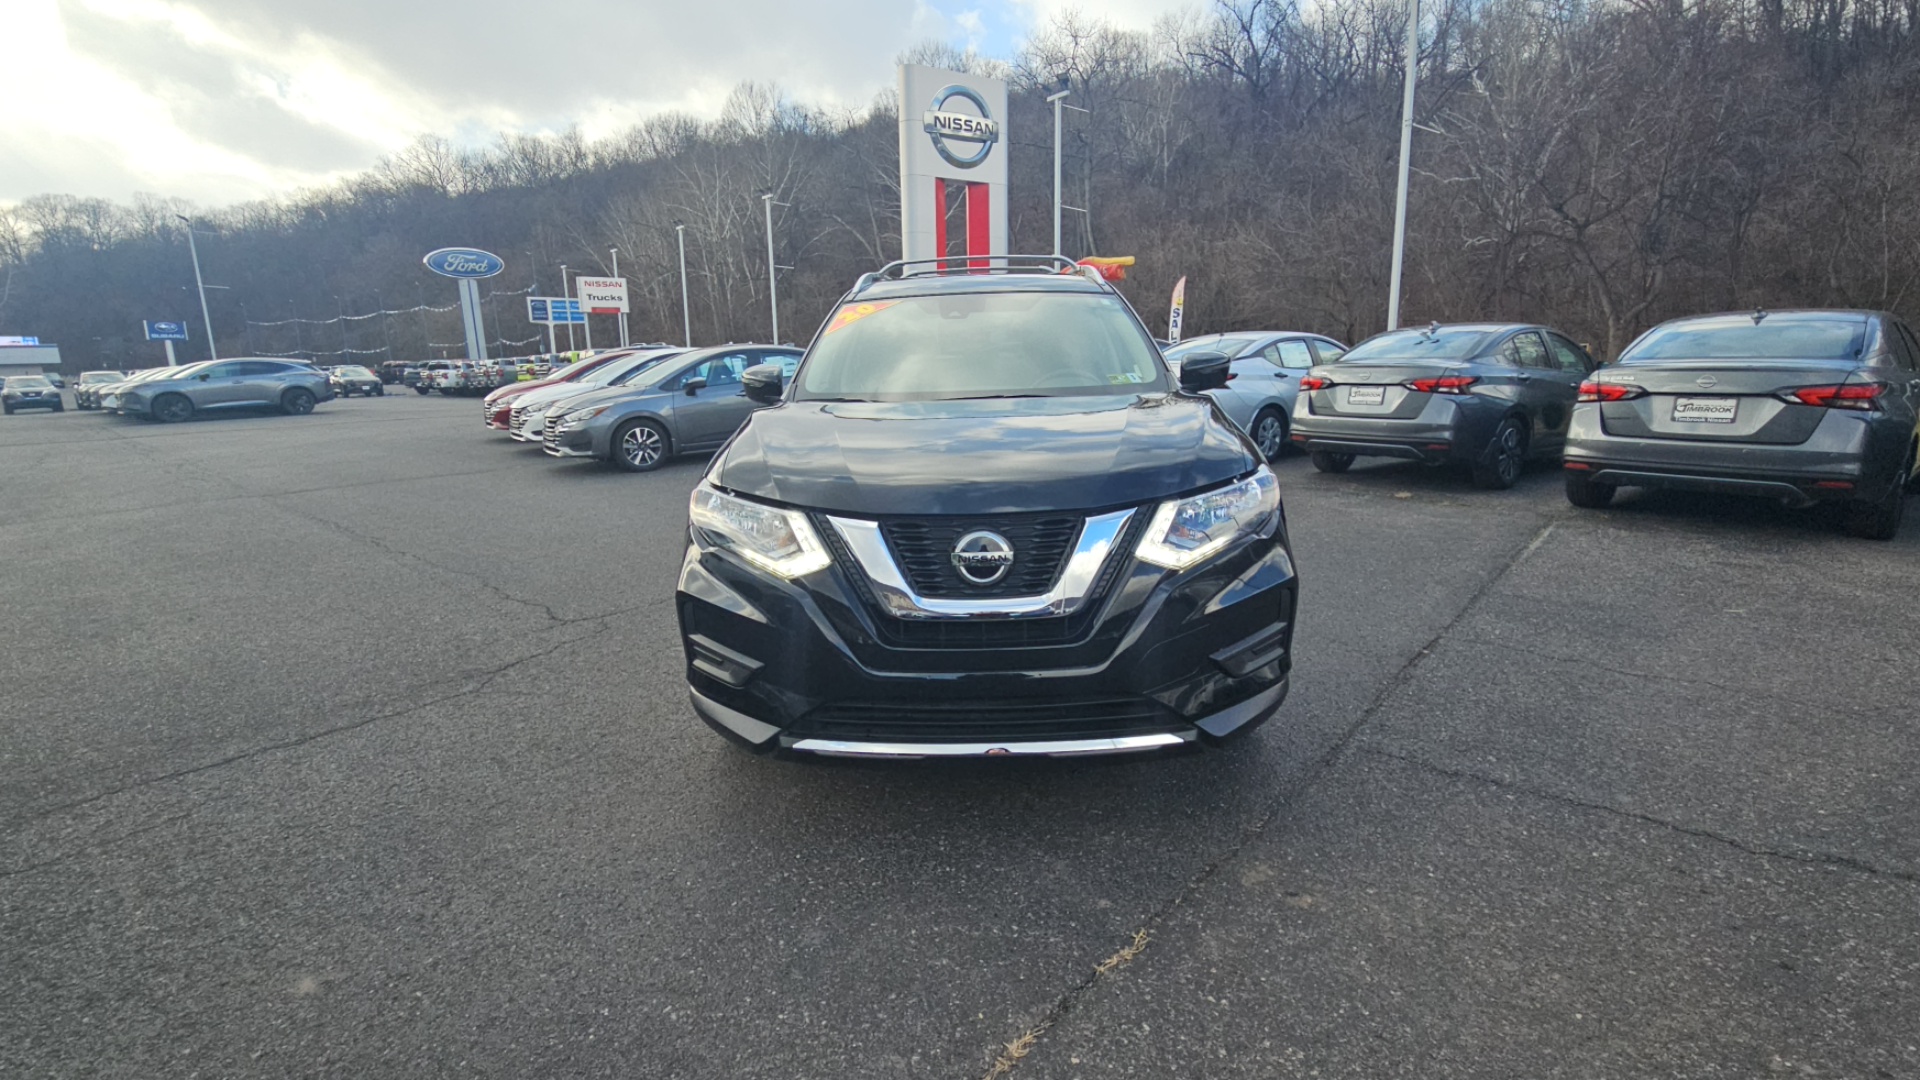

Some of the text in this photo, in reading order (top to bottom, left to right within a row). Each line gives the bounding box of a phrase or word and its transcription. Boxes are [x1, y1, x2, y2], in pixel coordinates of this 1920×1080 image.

[934, 115, 994, 136] NISSAN
[444, 253, 488, 273] Ford
[584, 280, 623, 288] NISSAN
[586, 293, 623, 302] Trucks
[1170, 308, 1181, 343] SAL
[957, 554, 1008, 564] NISSAN
